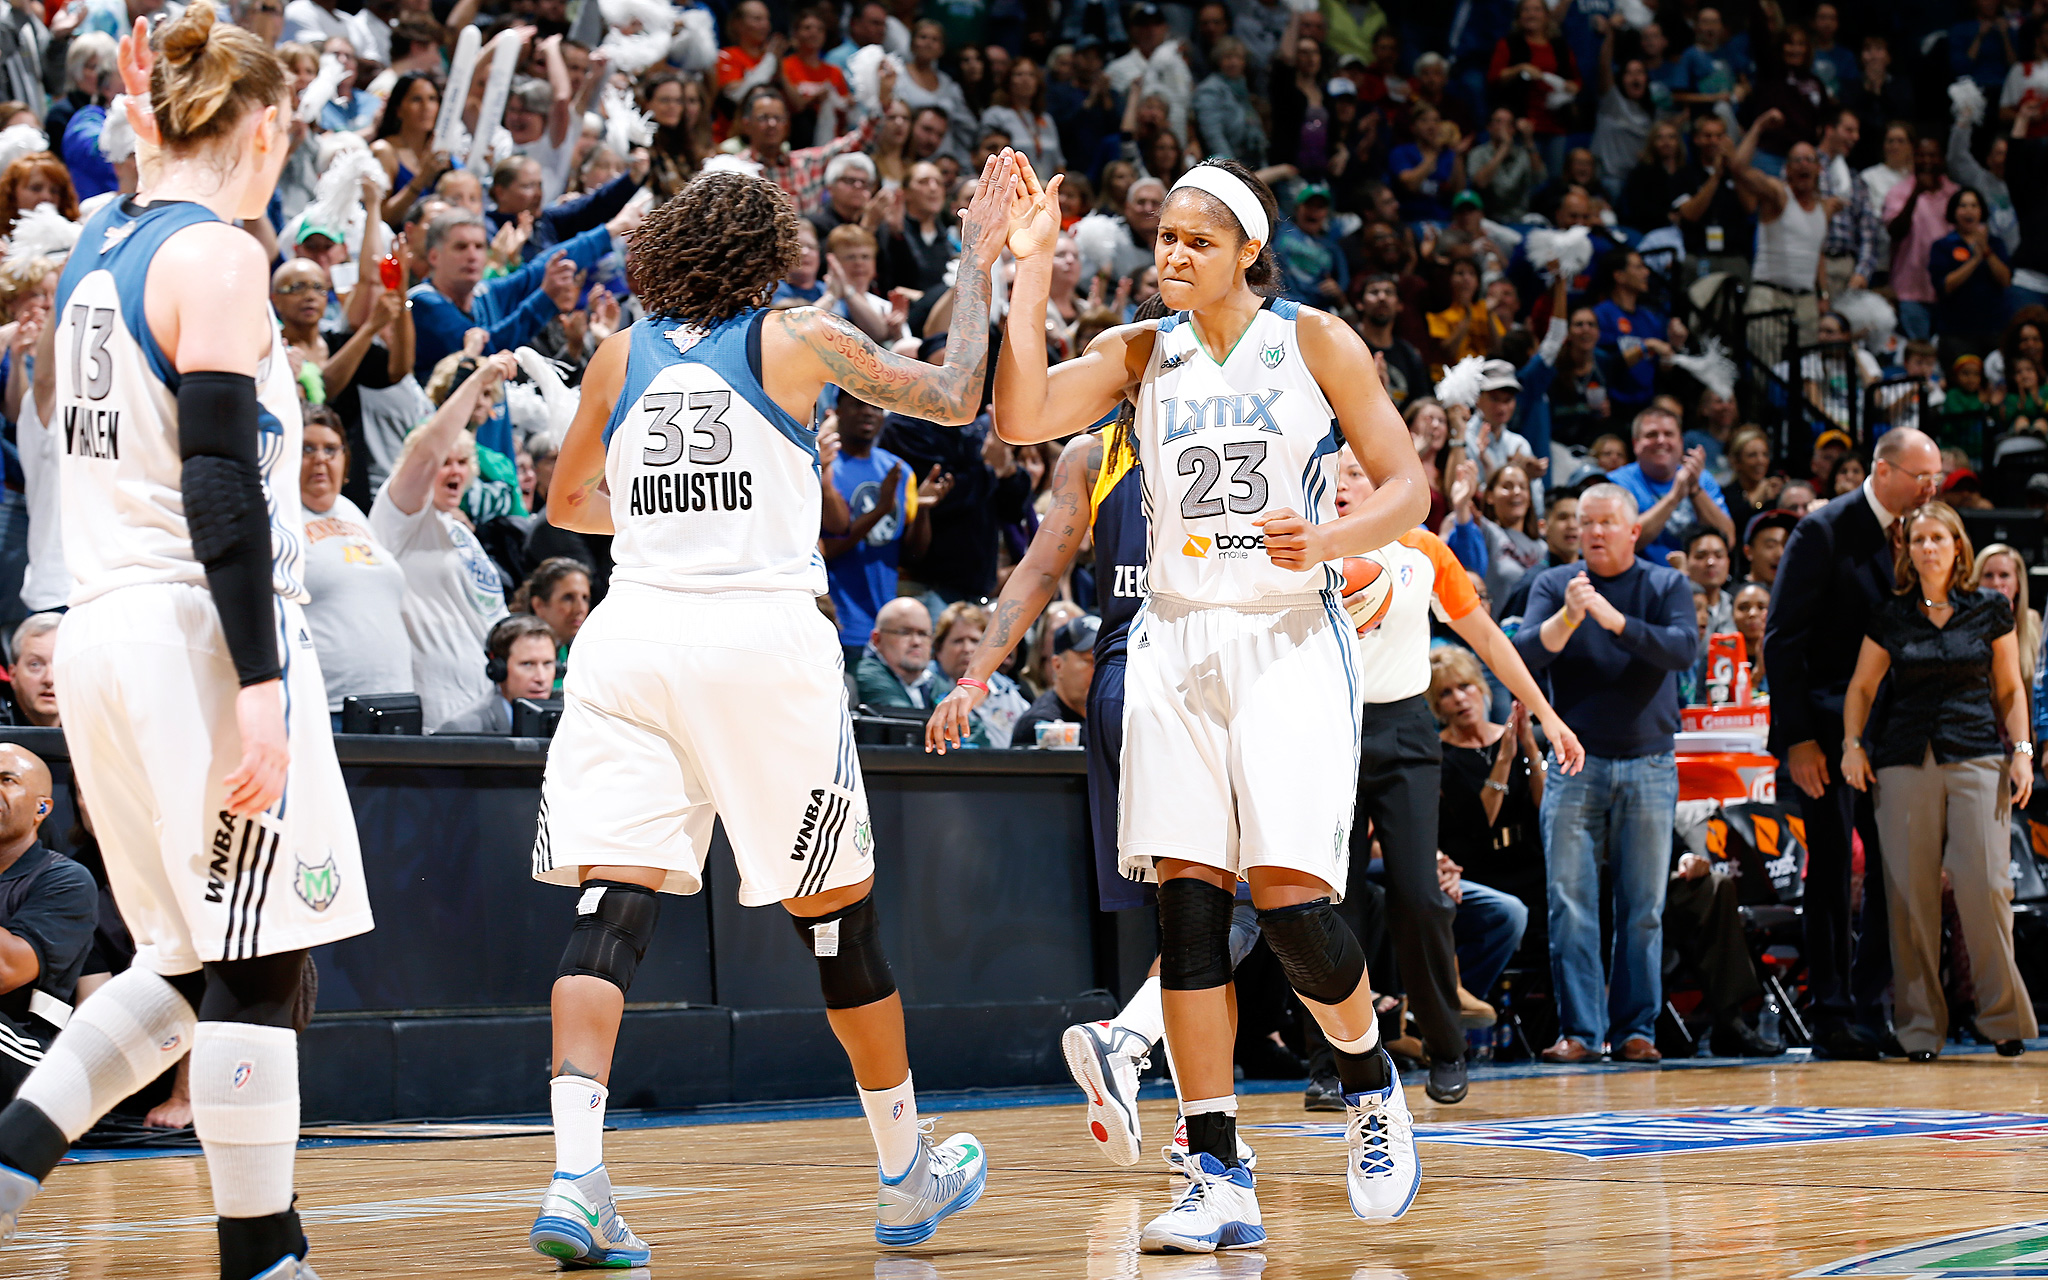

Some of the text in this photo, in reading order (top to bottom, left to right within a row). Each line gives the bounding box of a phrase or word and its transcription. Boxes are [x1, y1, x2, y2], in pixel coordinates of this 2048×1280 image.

[71, 304, 115, 400] 13
[643, 391, 732, 466] 33
[1160, 389, 1283, 446] LYNX
[631, 471, 753, 516] AUGUSTUS
[1177, 441, 1268, 519] 23
[1215, 532, 1265, 549] boos
[1113, 565, 1147, 598] ZEL
[205, 810, 238, 903] WNBA
[789, 789, 825, 861] WNBA
